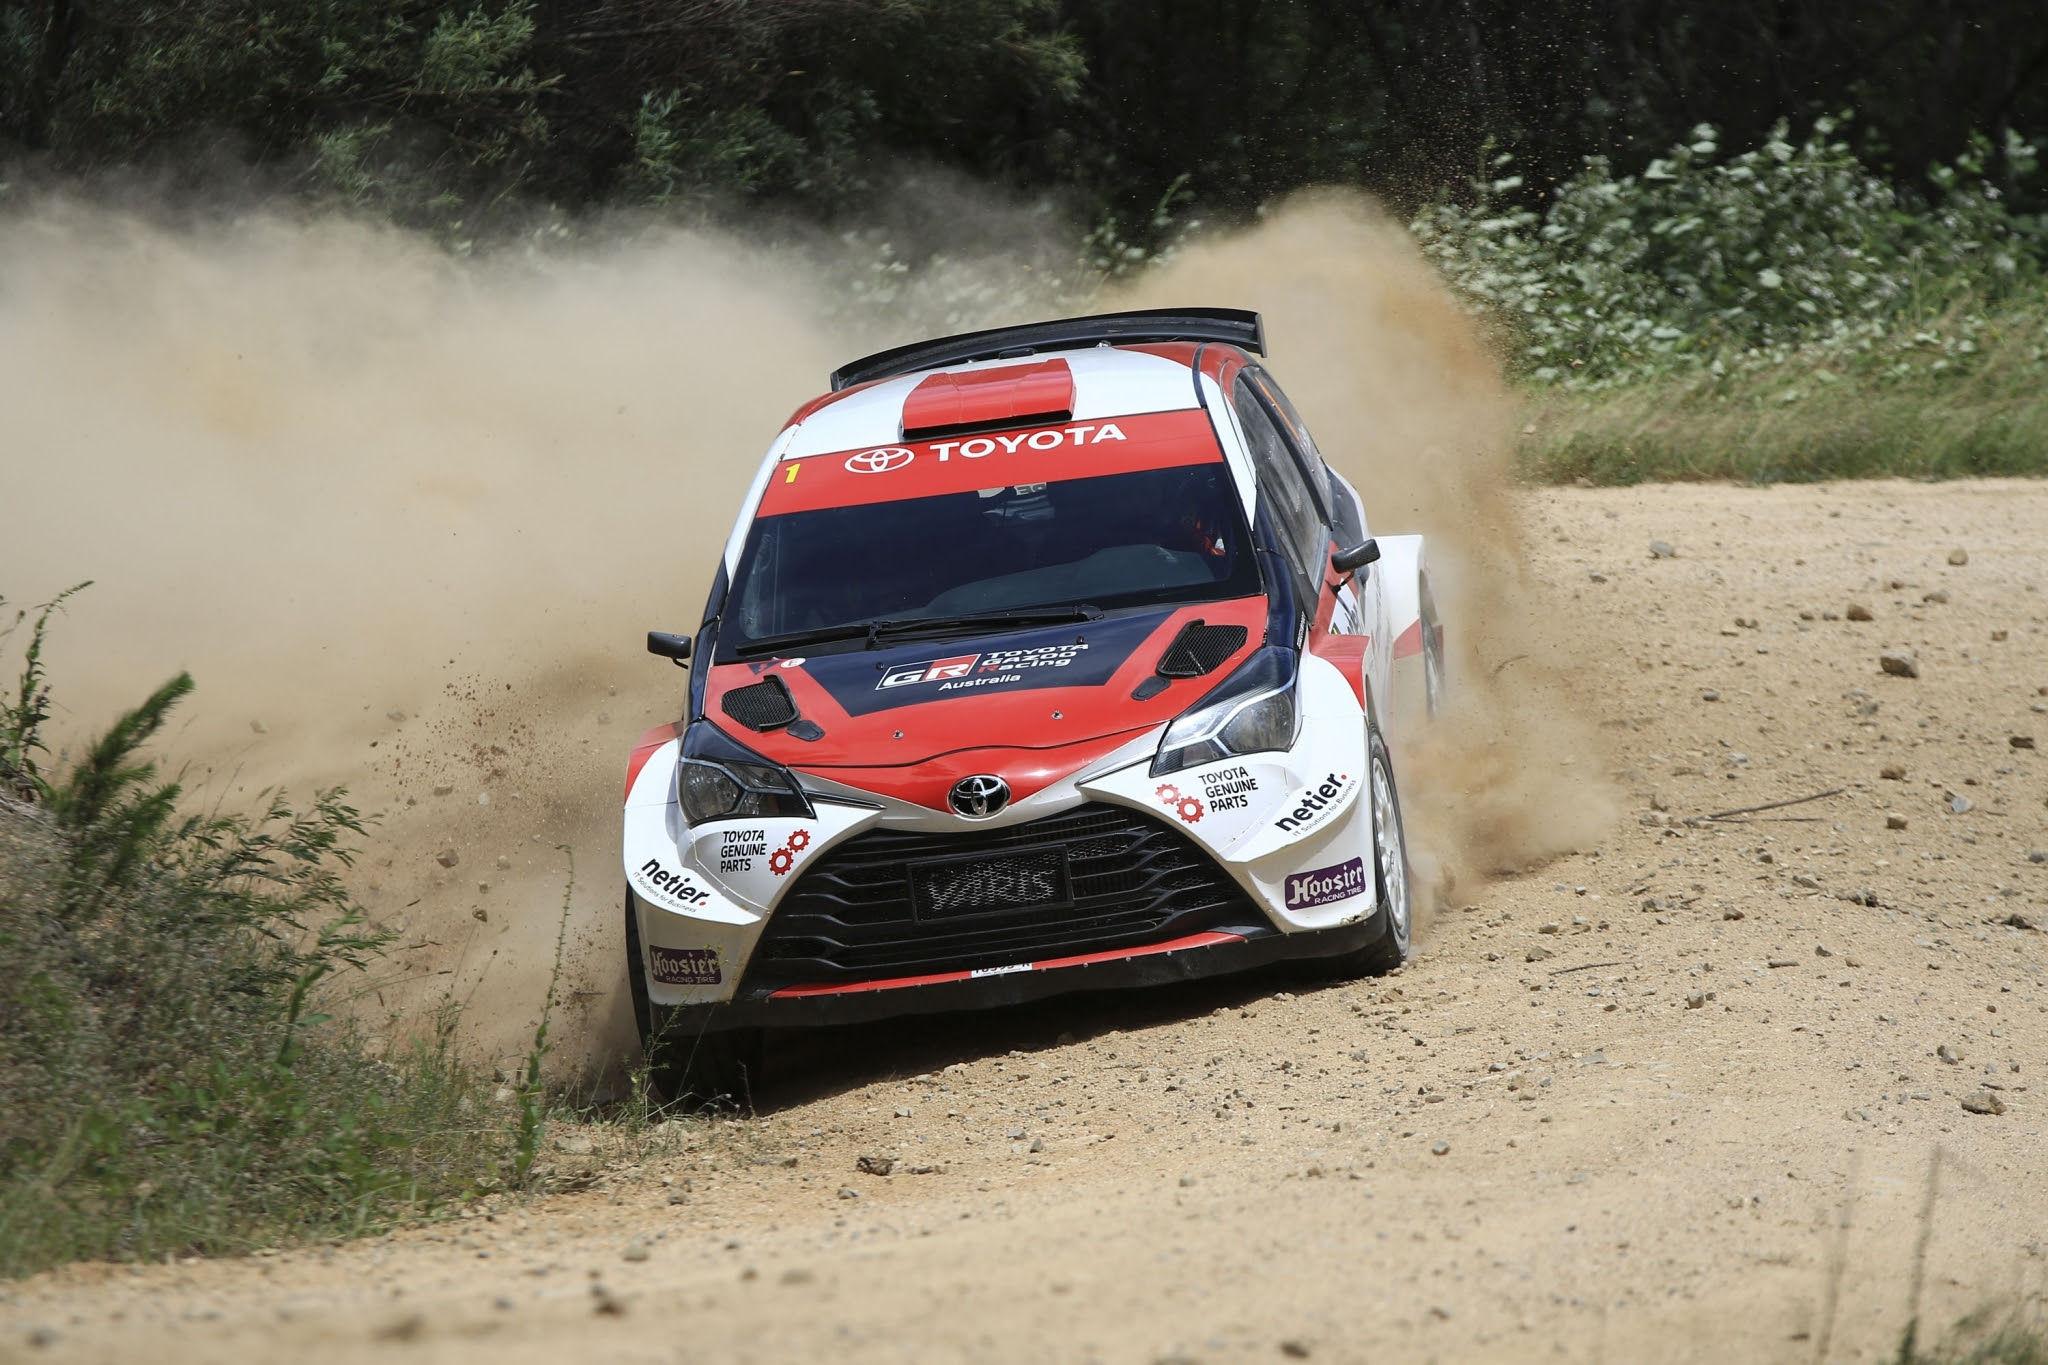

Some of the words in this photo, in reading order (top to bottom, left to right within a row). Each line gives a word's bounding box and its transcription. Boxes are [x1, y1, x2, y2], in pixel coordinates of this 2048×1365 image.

[930, 423, 1127, 461] TOYOTA
[785, 463, 801, 483] 1
[981, 651, 1077, 666] GAZOO
[986, 643, 1089, 658] TOYOTA
[882, 663, 970, 687] GR
[977, 658, 1072, 673] Racing
[938, 673, 1021, 691] Australia
[1198, 766, 1249, 785] TOYOTA
[1205, 778, 1259, 799] GENUINE
[1210, 794, 1248, 813] PARTS
[722, 829, 764, 844] TOYOTA
[720, 843, 767, 859] GENUINE
[720, 858, 751, 874] PARTS
[1287, 864, 1362, 905] Hoosier
[1314, 891, 1346, 905] RACING
[1346, 885, 1362, 896] TIRE
[651, 951, 719, 977] Hoosier
